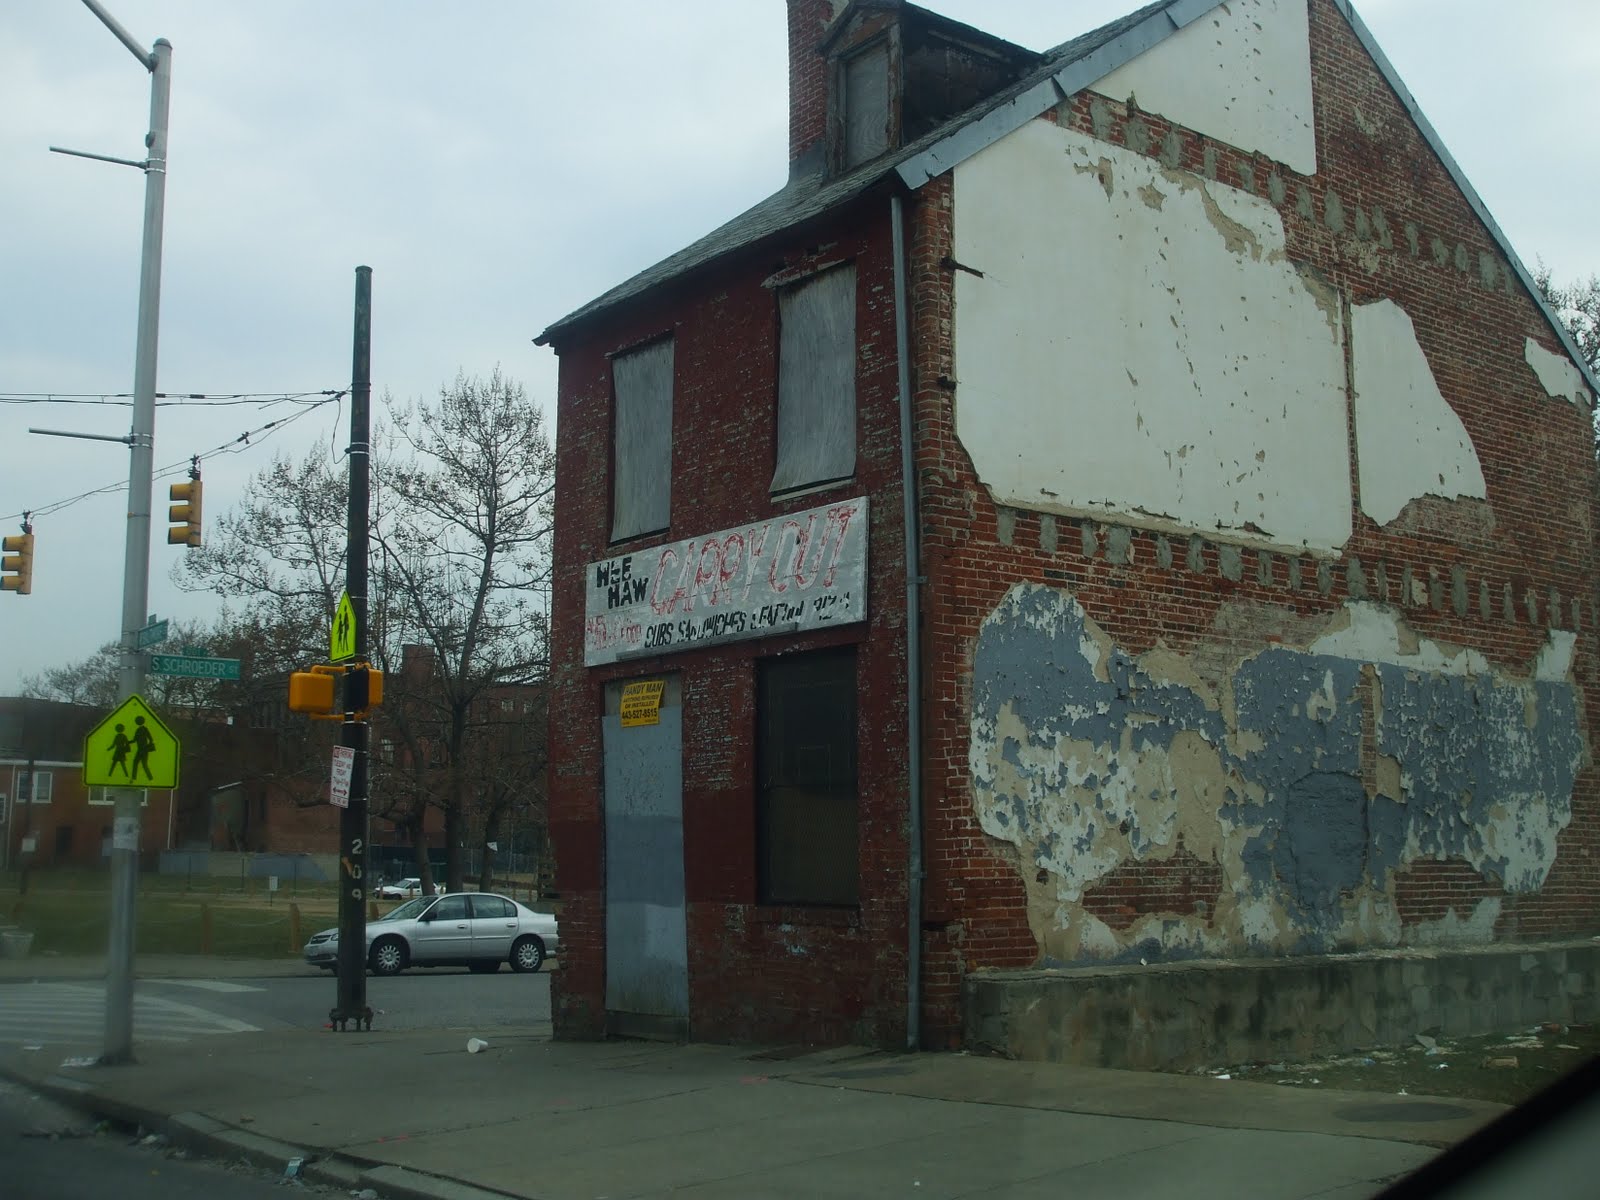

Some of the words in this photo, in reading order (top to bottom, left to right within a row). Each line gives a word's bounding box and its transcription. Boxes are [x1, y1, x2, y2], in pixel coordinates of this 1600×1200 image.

[769, 506, 858, 593] OUT
[608, 577, 650, 609] HAW
[163, 658, 226, 676] SCHROEDER
[647, 683, 662, 692] MAN
